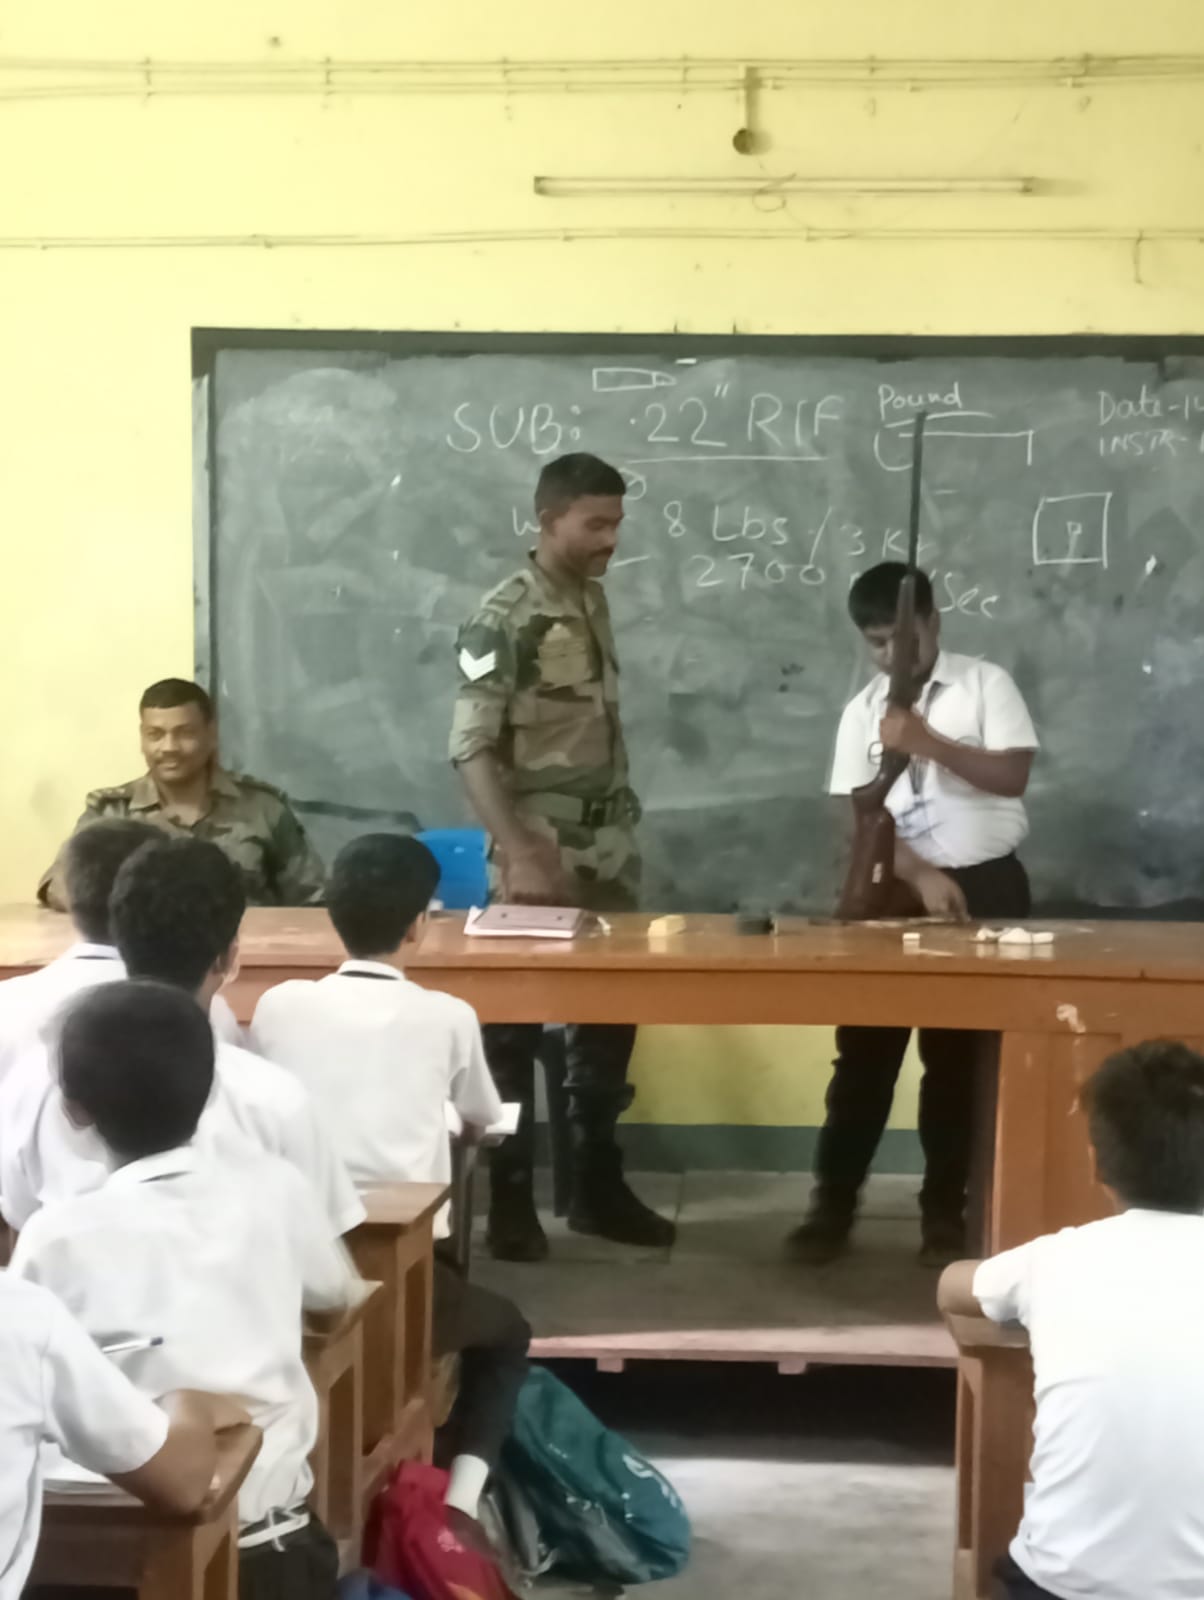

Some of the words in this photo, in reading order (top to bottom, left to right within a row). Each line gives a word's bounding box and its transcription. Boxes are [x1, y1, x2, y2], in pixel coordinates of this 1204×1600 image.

[877, 381, 963, 421] Pound
[663, 501, 686, 537] 8
[688, 552, 826, 590] 2700
